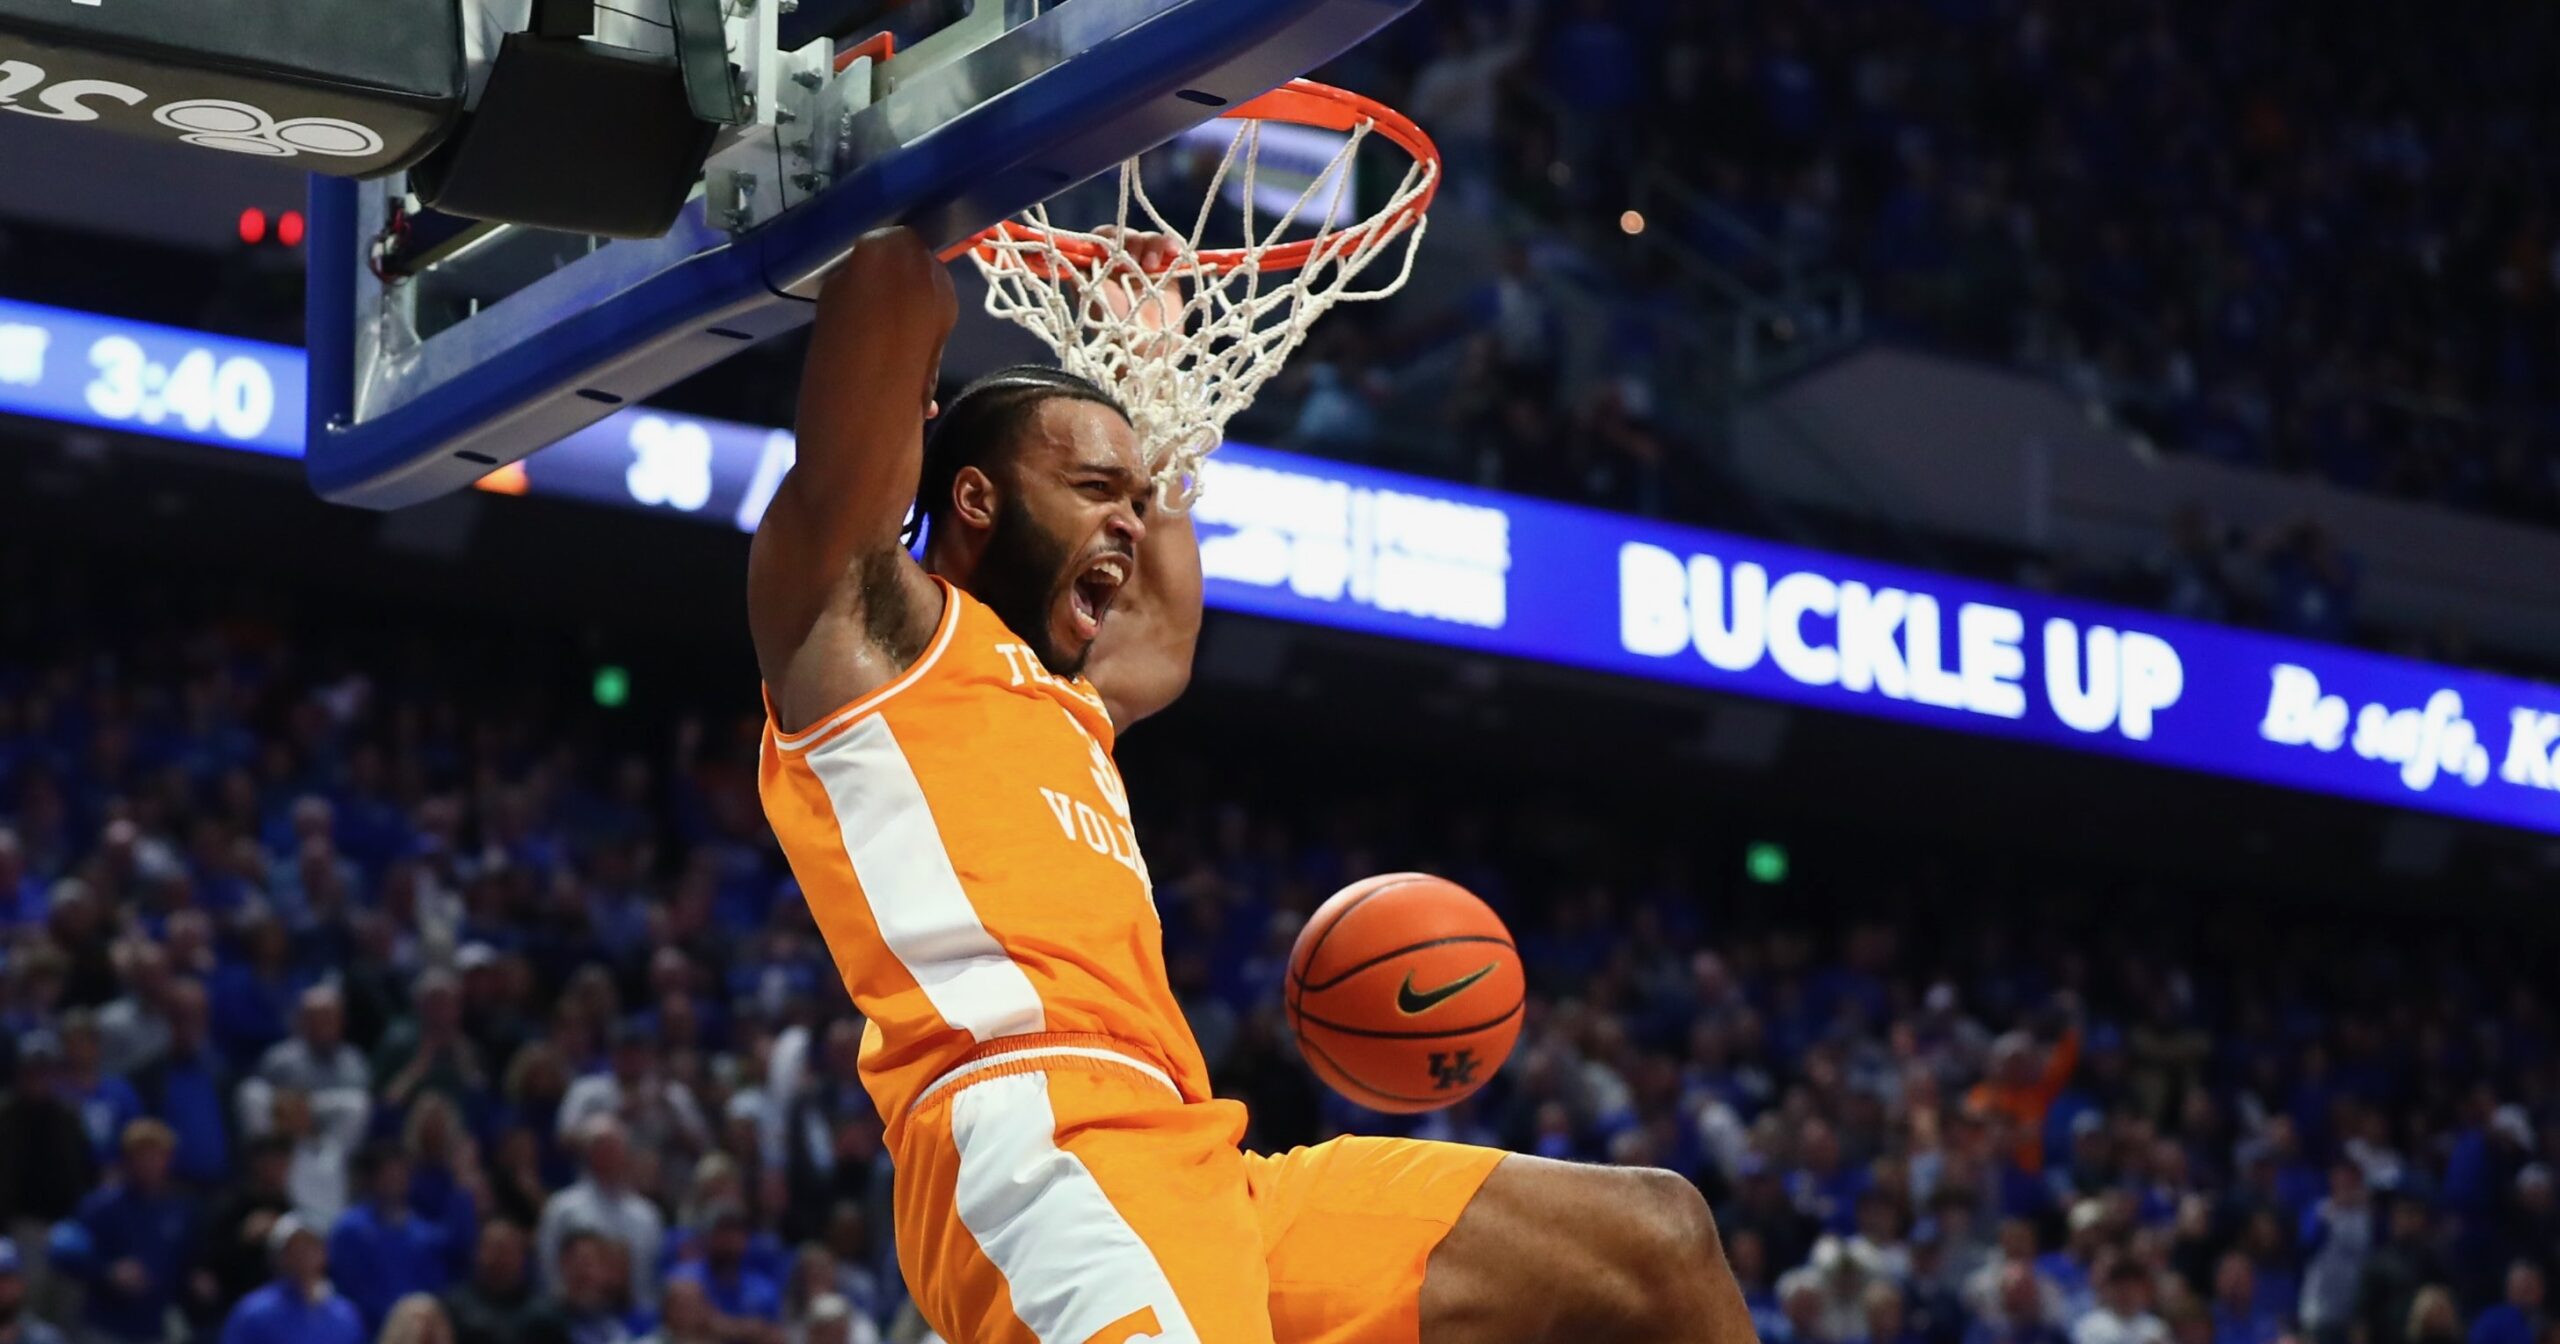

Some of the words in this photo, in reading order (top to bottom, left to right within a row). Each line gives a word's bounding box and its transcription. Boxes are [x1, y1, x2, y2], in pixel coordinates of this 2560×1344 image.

[84, 334, 275, 440] 3:40
[1619, 541, 2027, 720] BUCKLE
[2042, 616, 2184, 742] UP
[2258, 662, 2350, 753] Be
